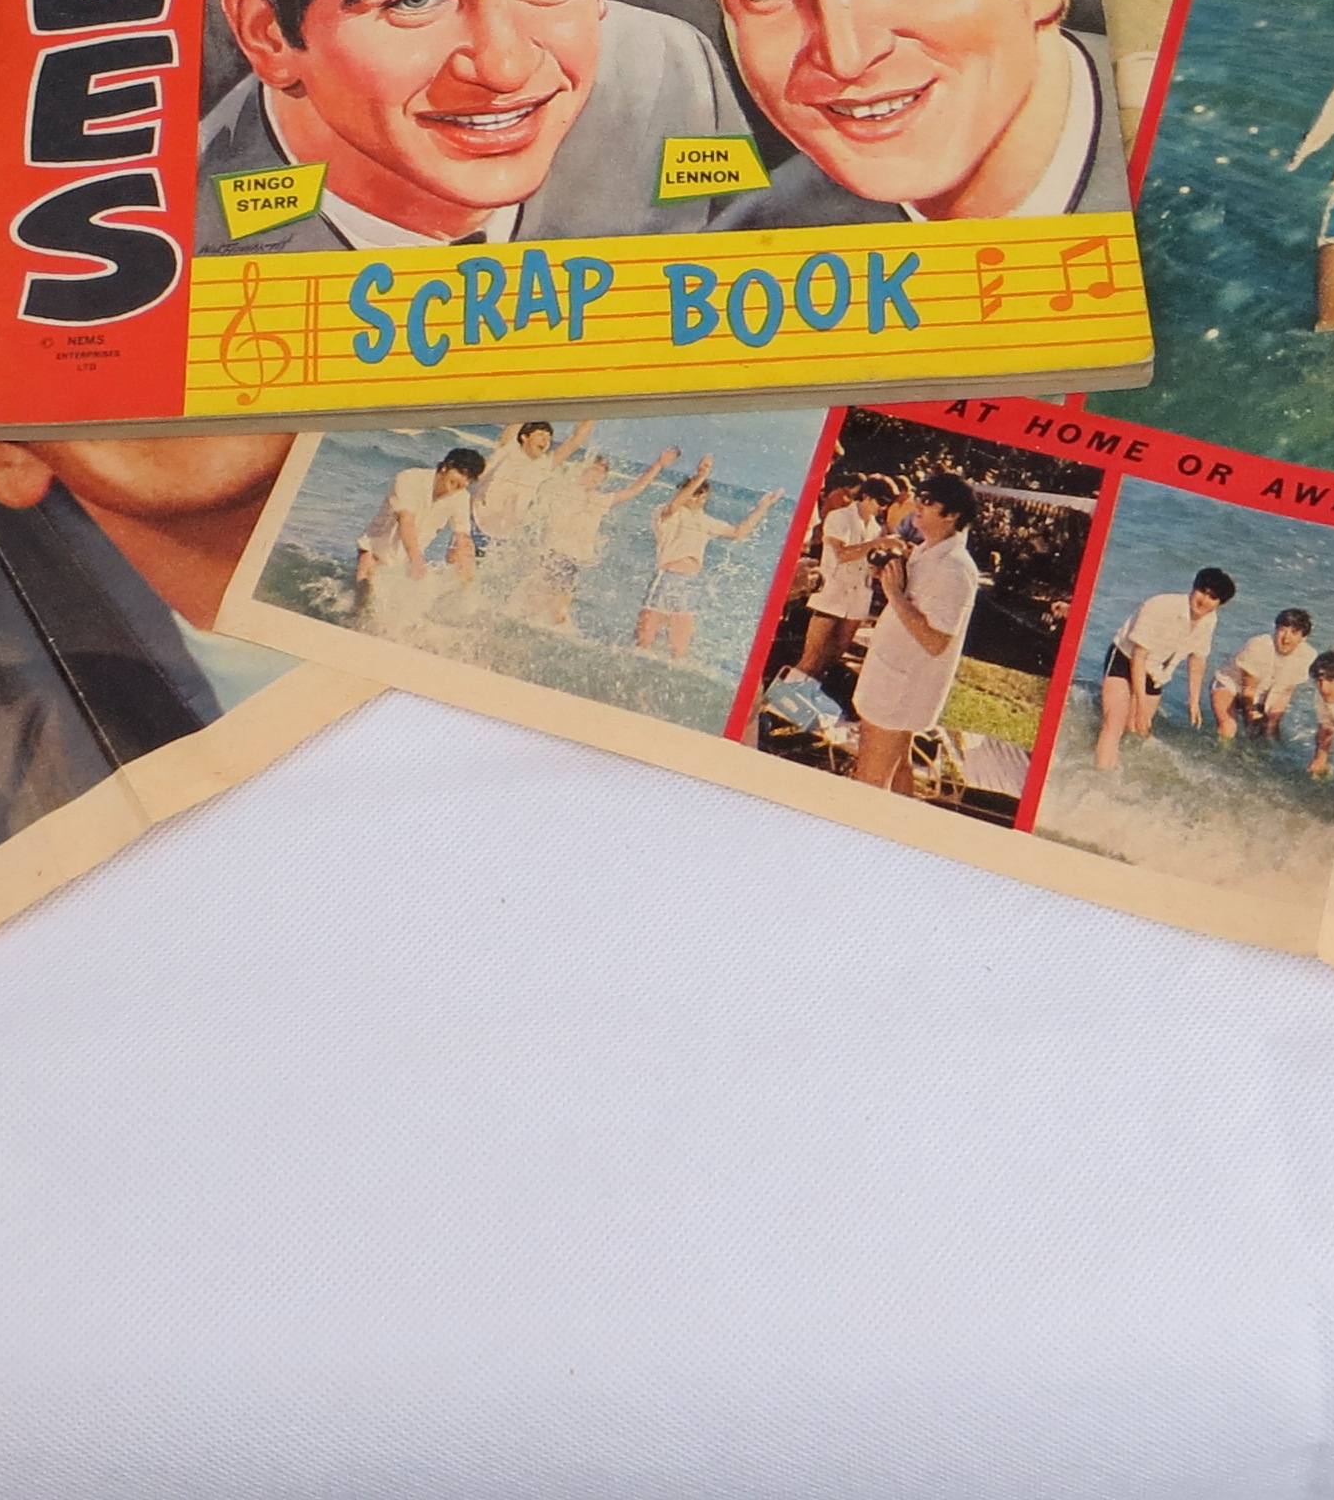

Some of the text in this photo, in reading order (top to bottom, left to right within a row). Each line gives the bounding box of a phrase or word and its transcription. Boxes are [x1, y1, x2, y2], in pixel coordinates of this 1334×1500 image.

[675, 150, 729, 163] JOHN
[233, 176, 295, 192] RINGO
[665, 170, 740, 184] LENNON
[236, 195, 299, 212] STARR
[347, 247, 923, 366] SCRAP BOOK
[67, 334, 105, 345] NEMS
[944, 399, 1000, 423] AT
[1024, 415, 1150, 463] HOME
[1177, 454, 1235, 486] OR
